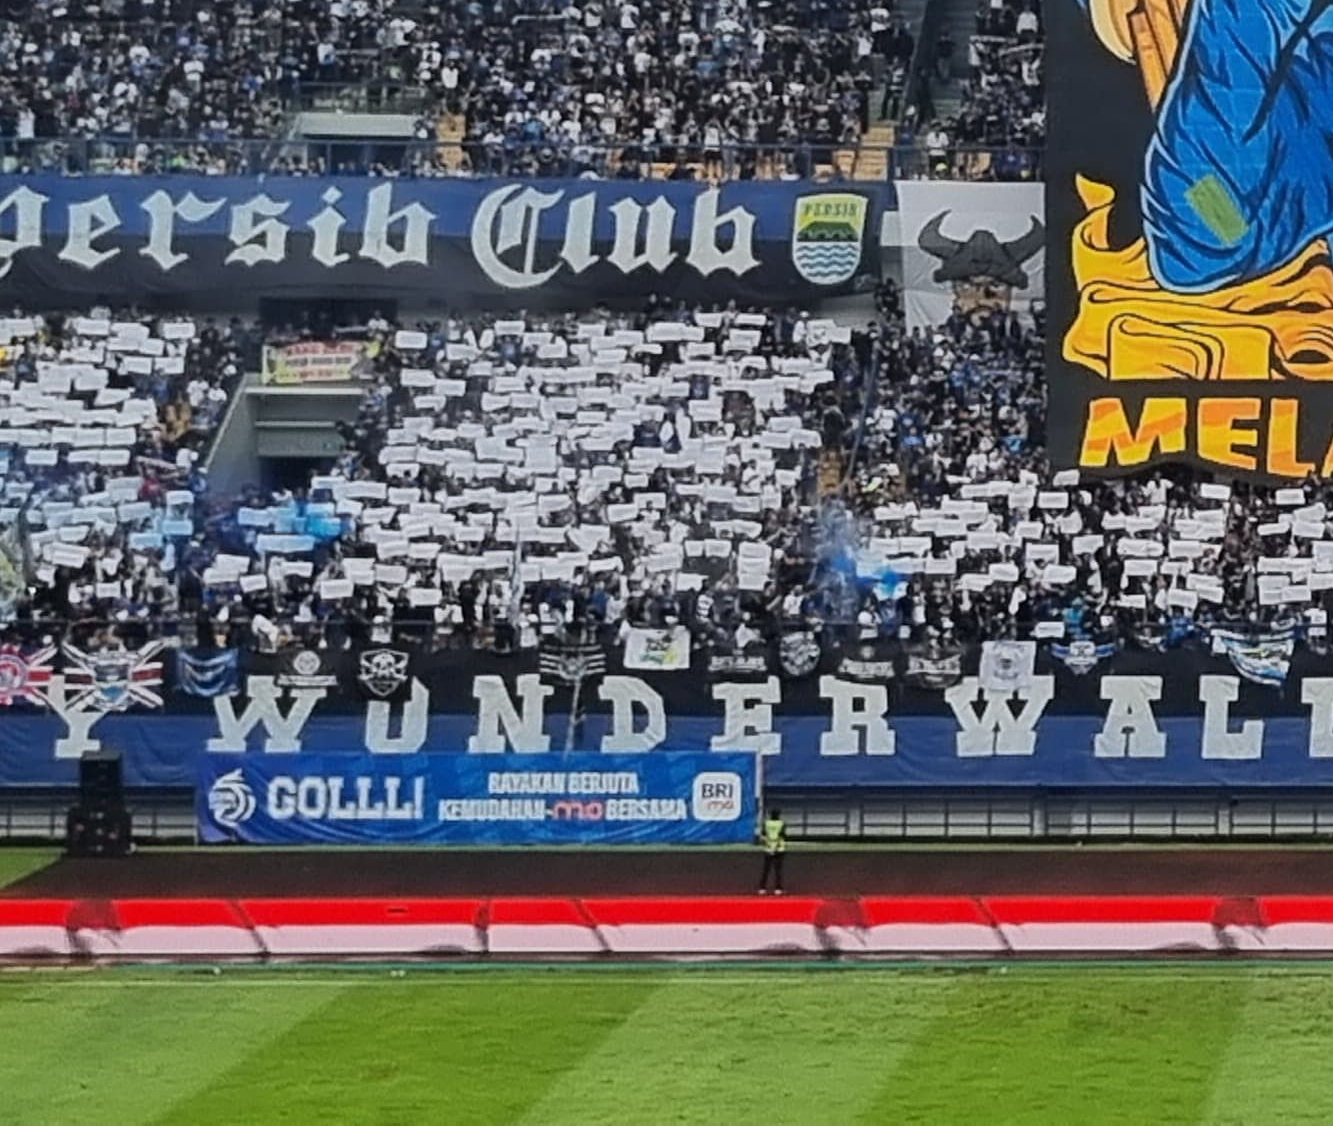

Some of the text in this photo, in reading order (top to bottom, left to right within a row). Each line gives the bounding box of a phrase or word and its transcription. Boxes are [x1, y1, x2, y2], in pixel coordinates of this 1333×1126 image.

[472, 183, 763, 289] Club
[266, 775, 425, 821] GOLLL!
[701, 783, 734, 799] BRI
[605, 799, 688, 821] BERSAMA
